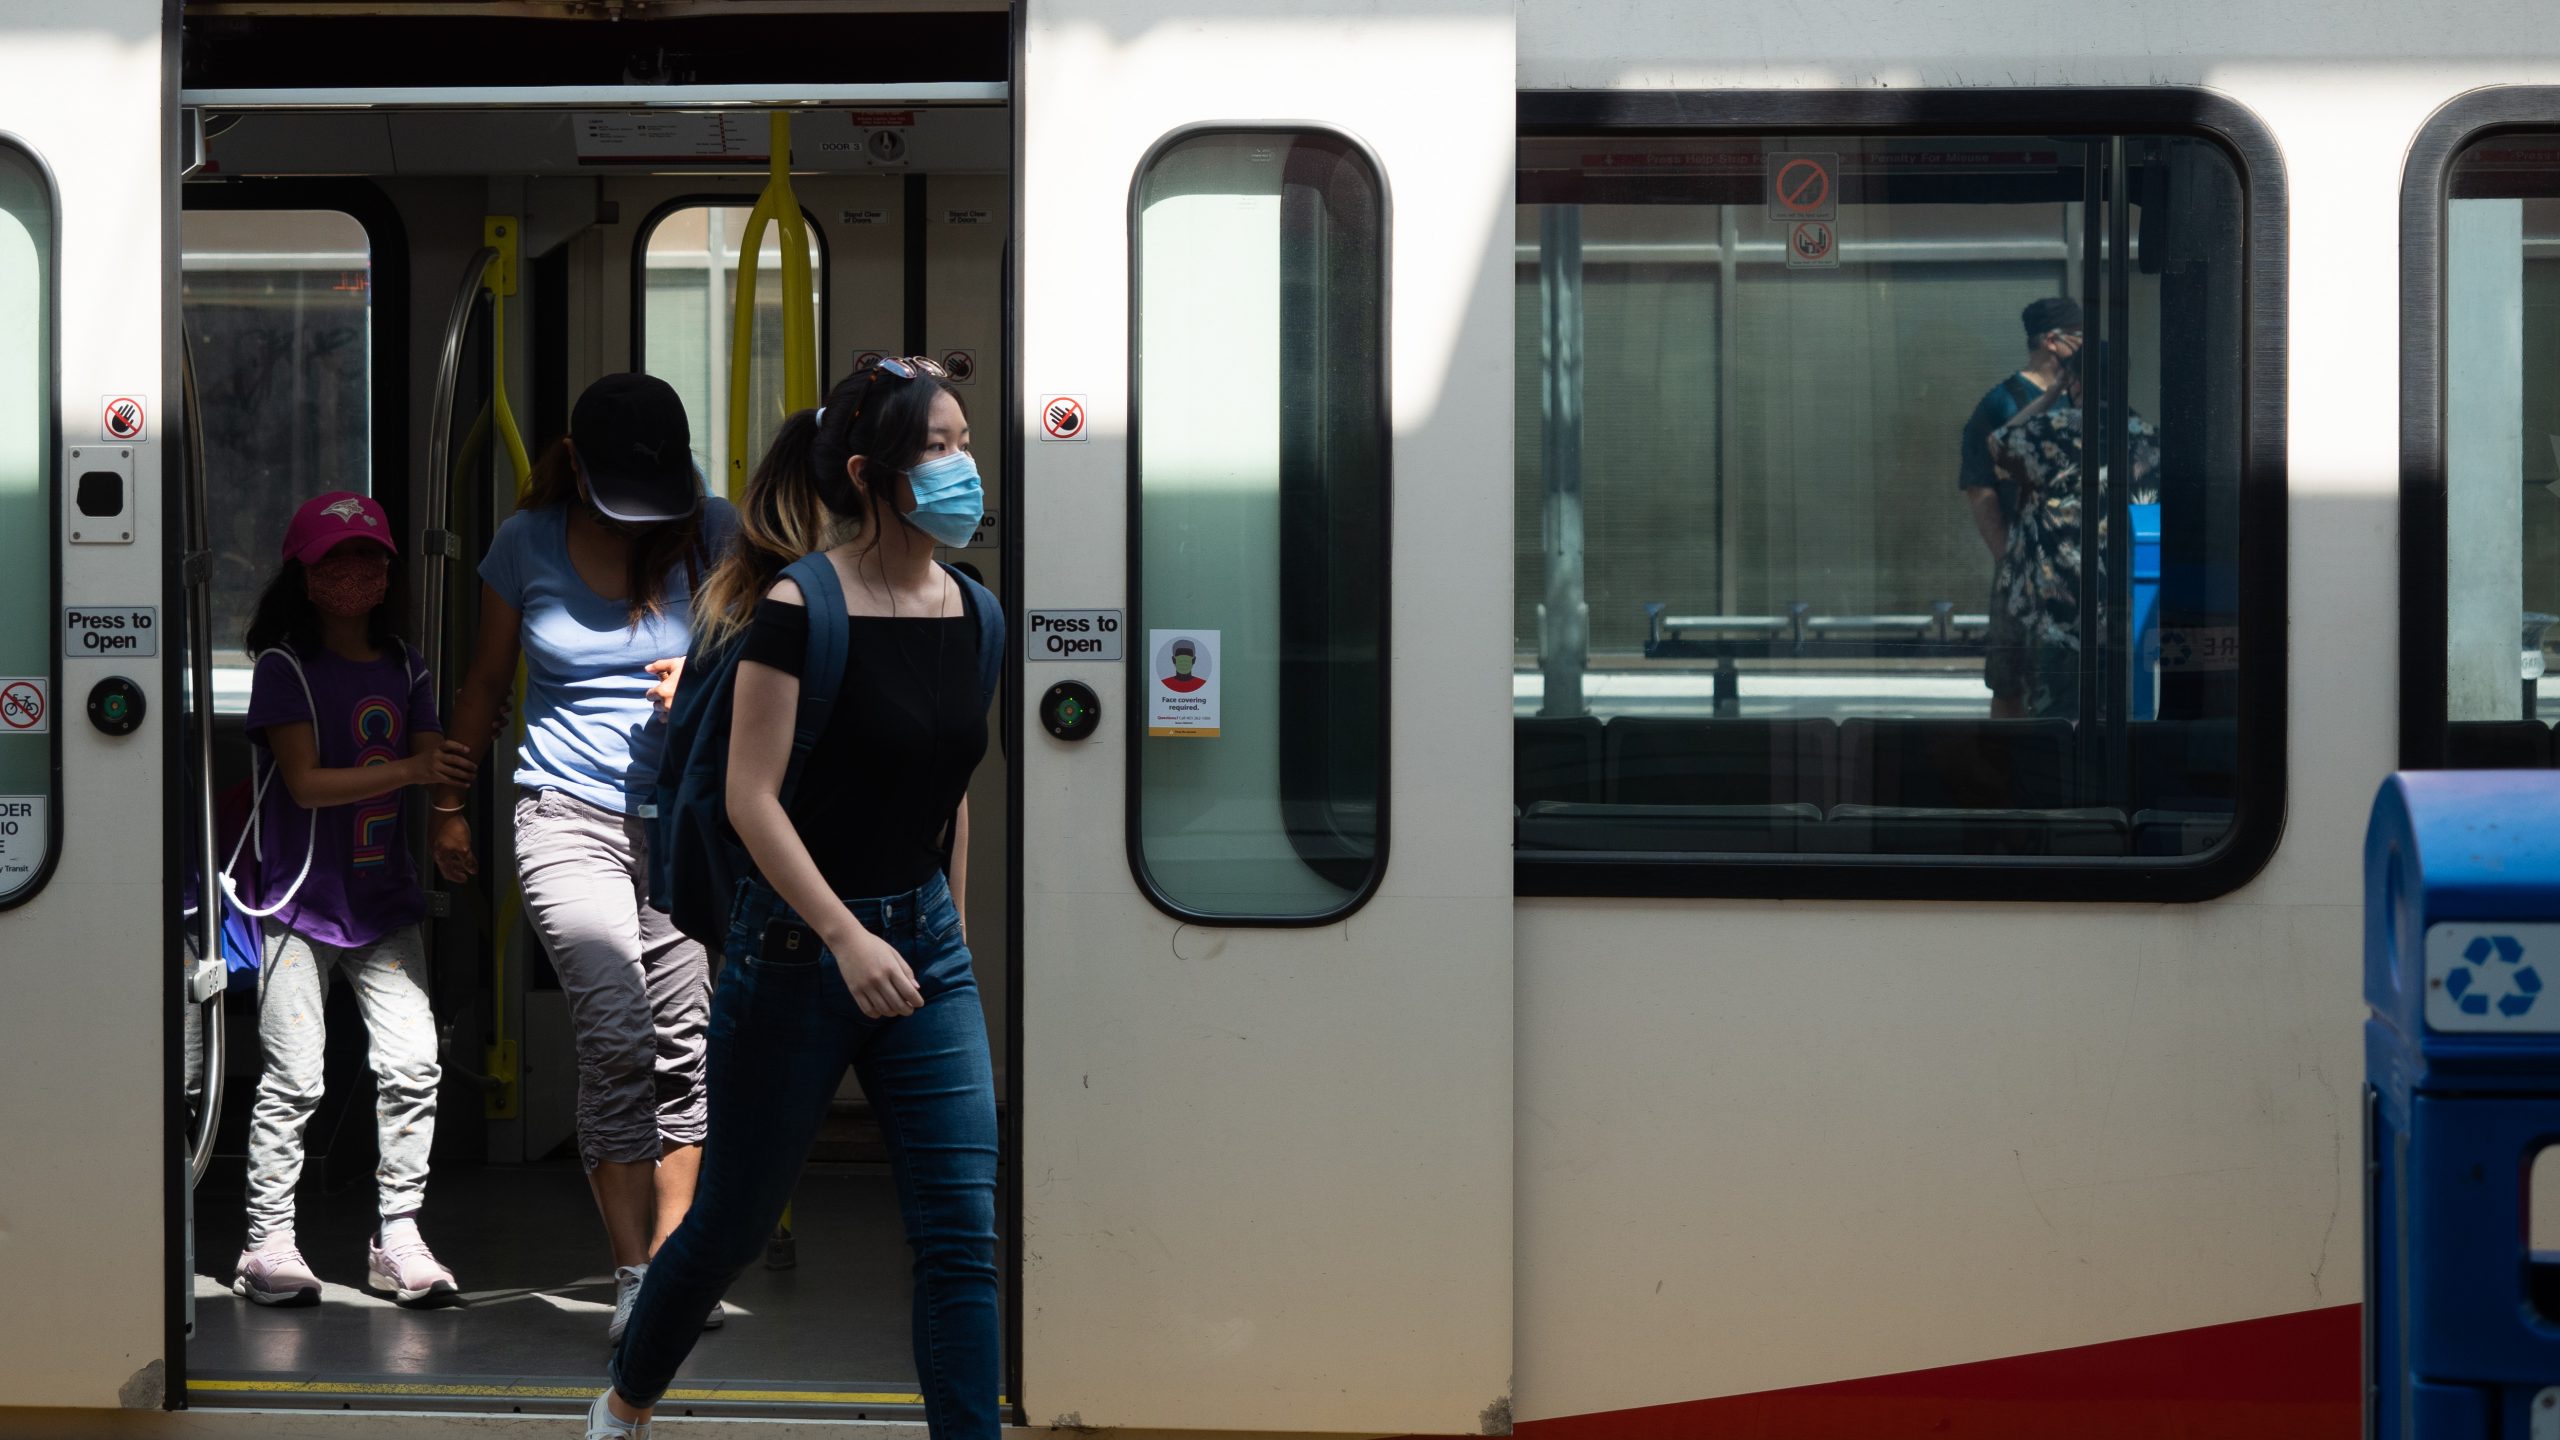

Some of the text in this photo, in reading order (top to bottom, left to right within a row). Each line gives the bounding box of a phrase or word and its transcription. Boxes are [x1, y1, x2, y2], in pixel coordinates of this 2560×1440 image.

[822, 143, 860, 151] DOOR 3
[1647, 153, 1680, 164] Press
[1752, 153, 1768, 164] Fo
[1871, 152, 1990, 165] Penalty For Misuse
[981, 515, 995, 527] to
[69, 612, 152, 629] Press to
[1031, 615, 1118, 632] Press to
[83, 631, 137, 653] Open
[1046, 635, 1102, 656] Open
[1178, 696, 1207, 704] covering
